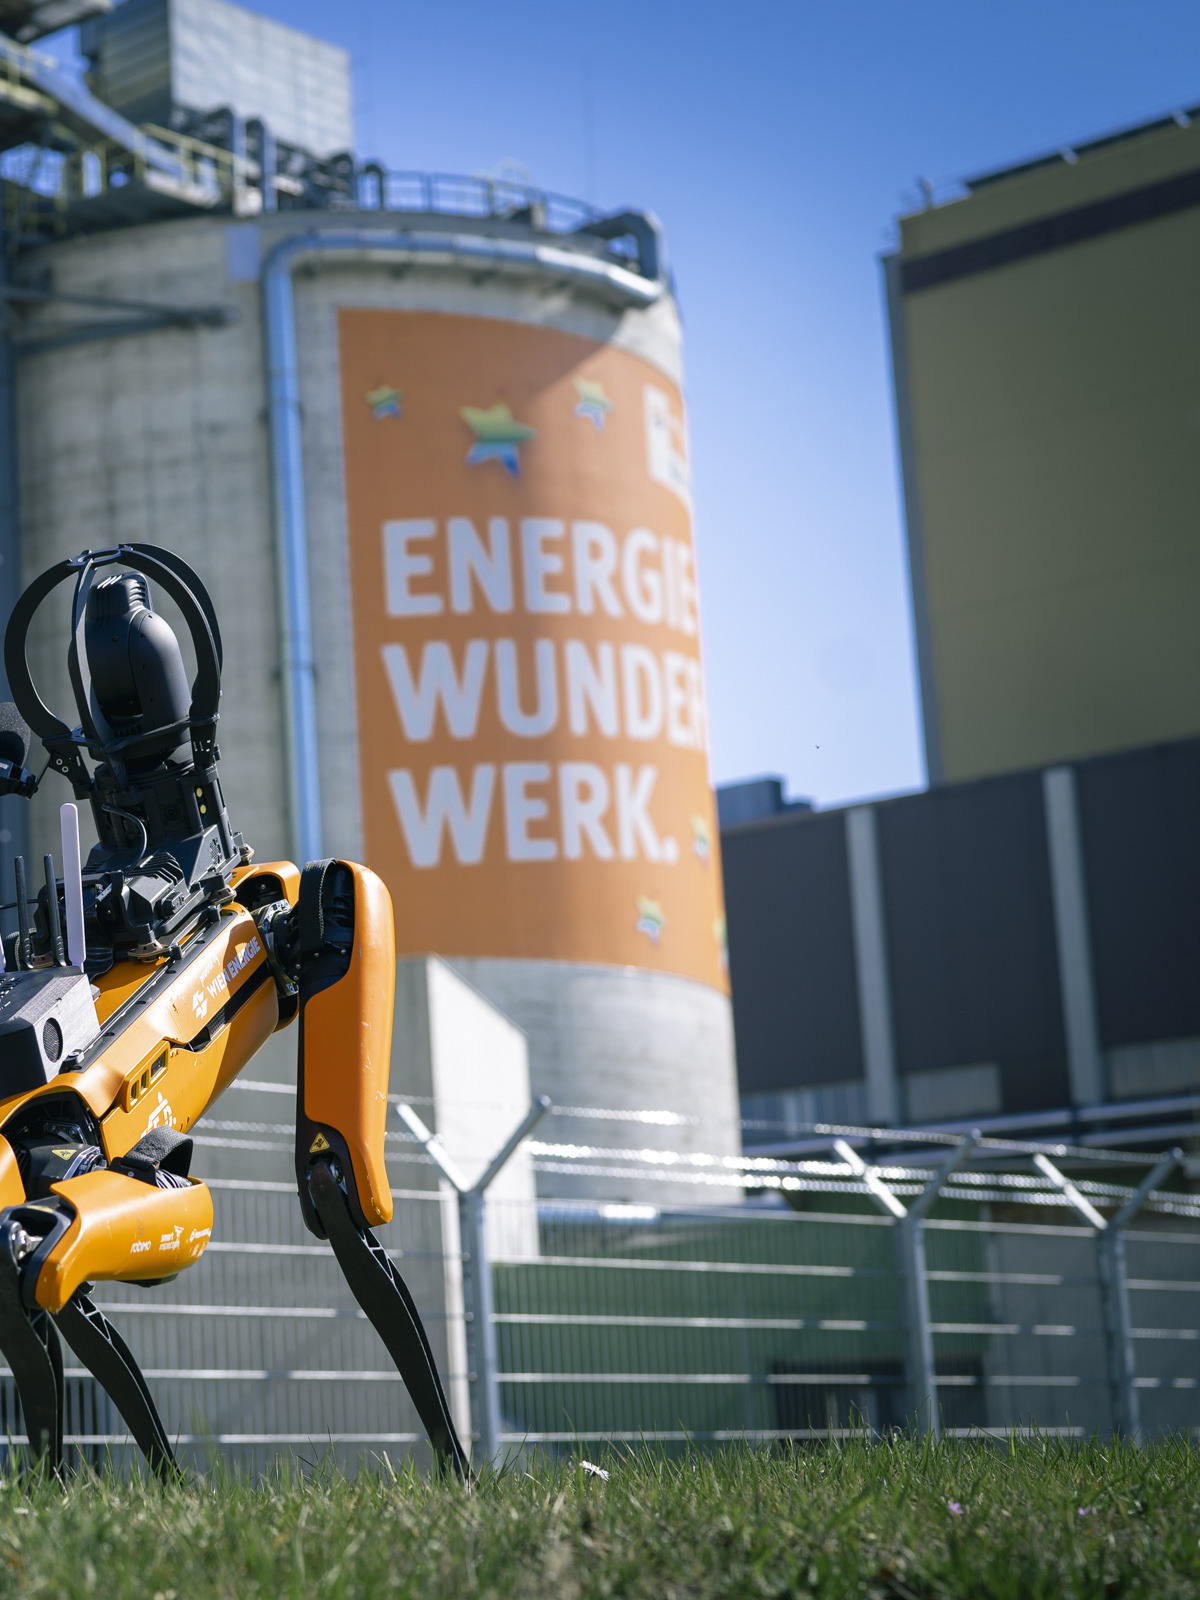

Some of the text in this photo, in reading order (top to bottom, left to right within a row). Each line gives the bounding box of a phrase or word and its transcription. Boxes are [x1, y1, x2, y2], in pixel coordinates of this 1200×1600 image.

[382, 517, 698, 637] ENERGIE
[387, 762, 679, 868] WERK.
[206, 967, 231, 999] WIEN
[227, 936, 261, 978] ENERGIE
